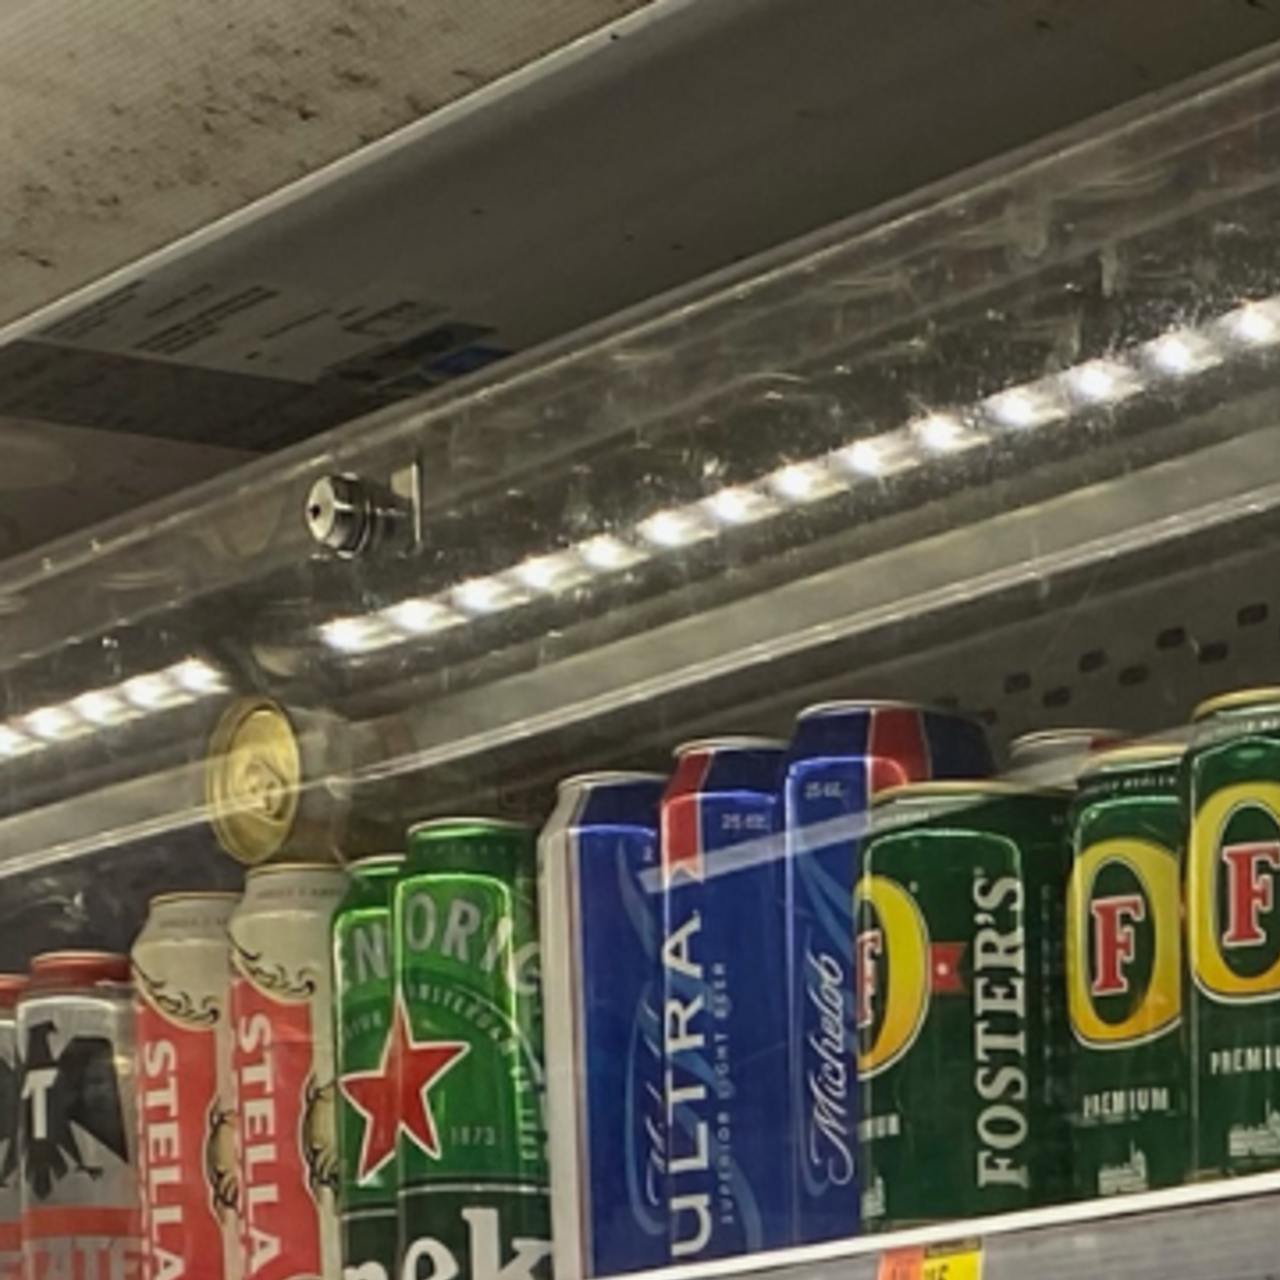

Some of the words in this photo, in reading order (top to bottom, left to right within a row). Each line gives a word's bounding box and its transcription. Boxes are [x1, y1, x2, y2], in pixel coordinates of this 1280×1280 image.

[806, 950, 856, 1188] Michelob
[973, 868, 1029, 1190] FOSTER'S
[1091, 895, 1143, 996] F
[238, 1013, 281, 1275] STELLA
[662, 908, 713, 1258] ULTRA
[1082, 1087, 1170, 1120] PREMIUM
